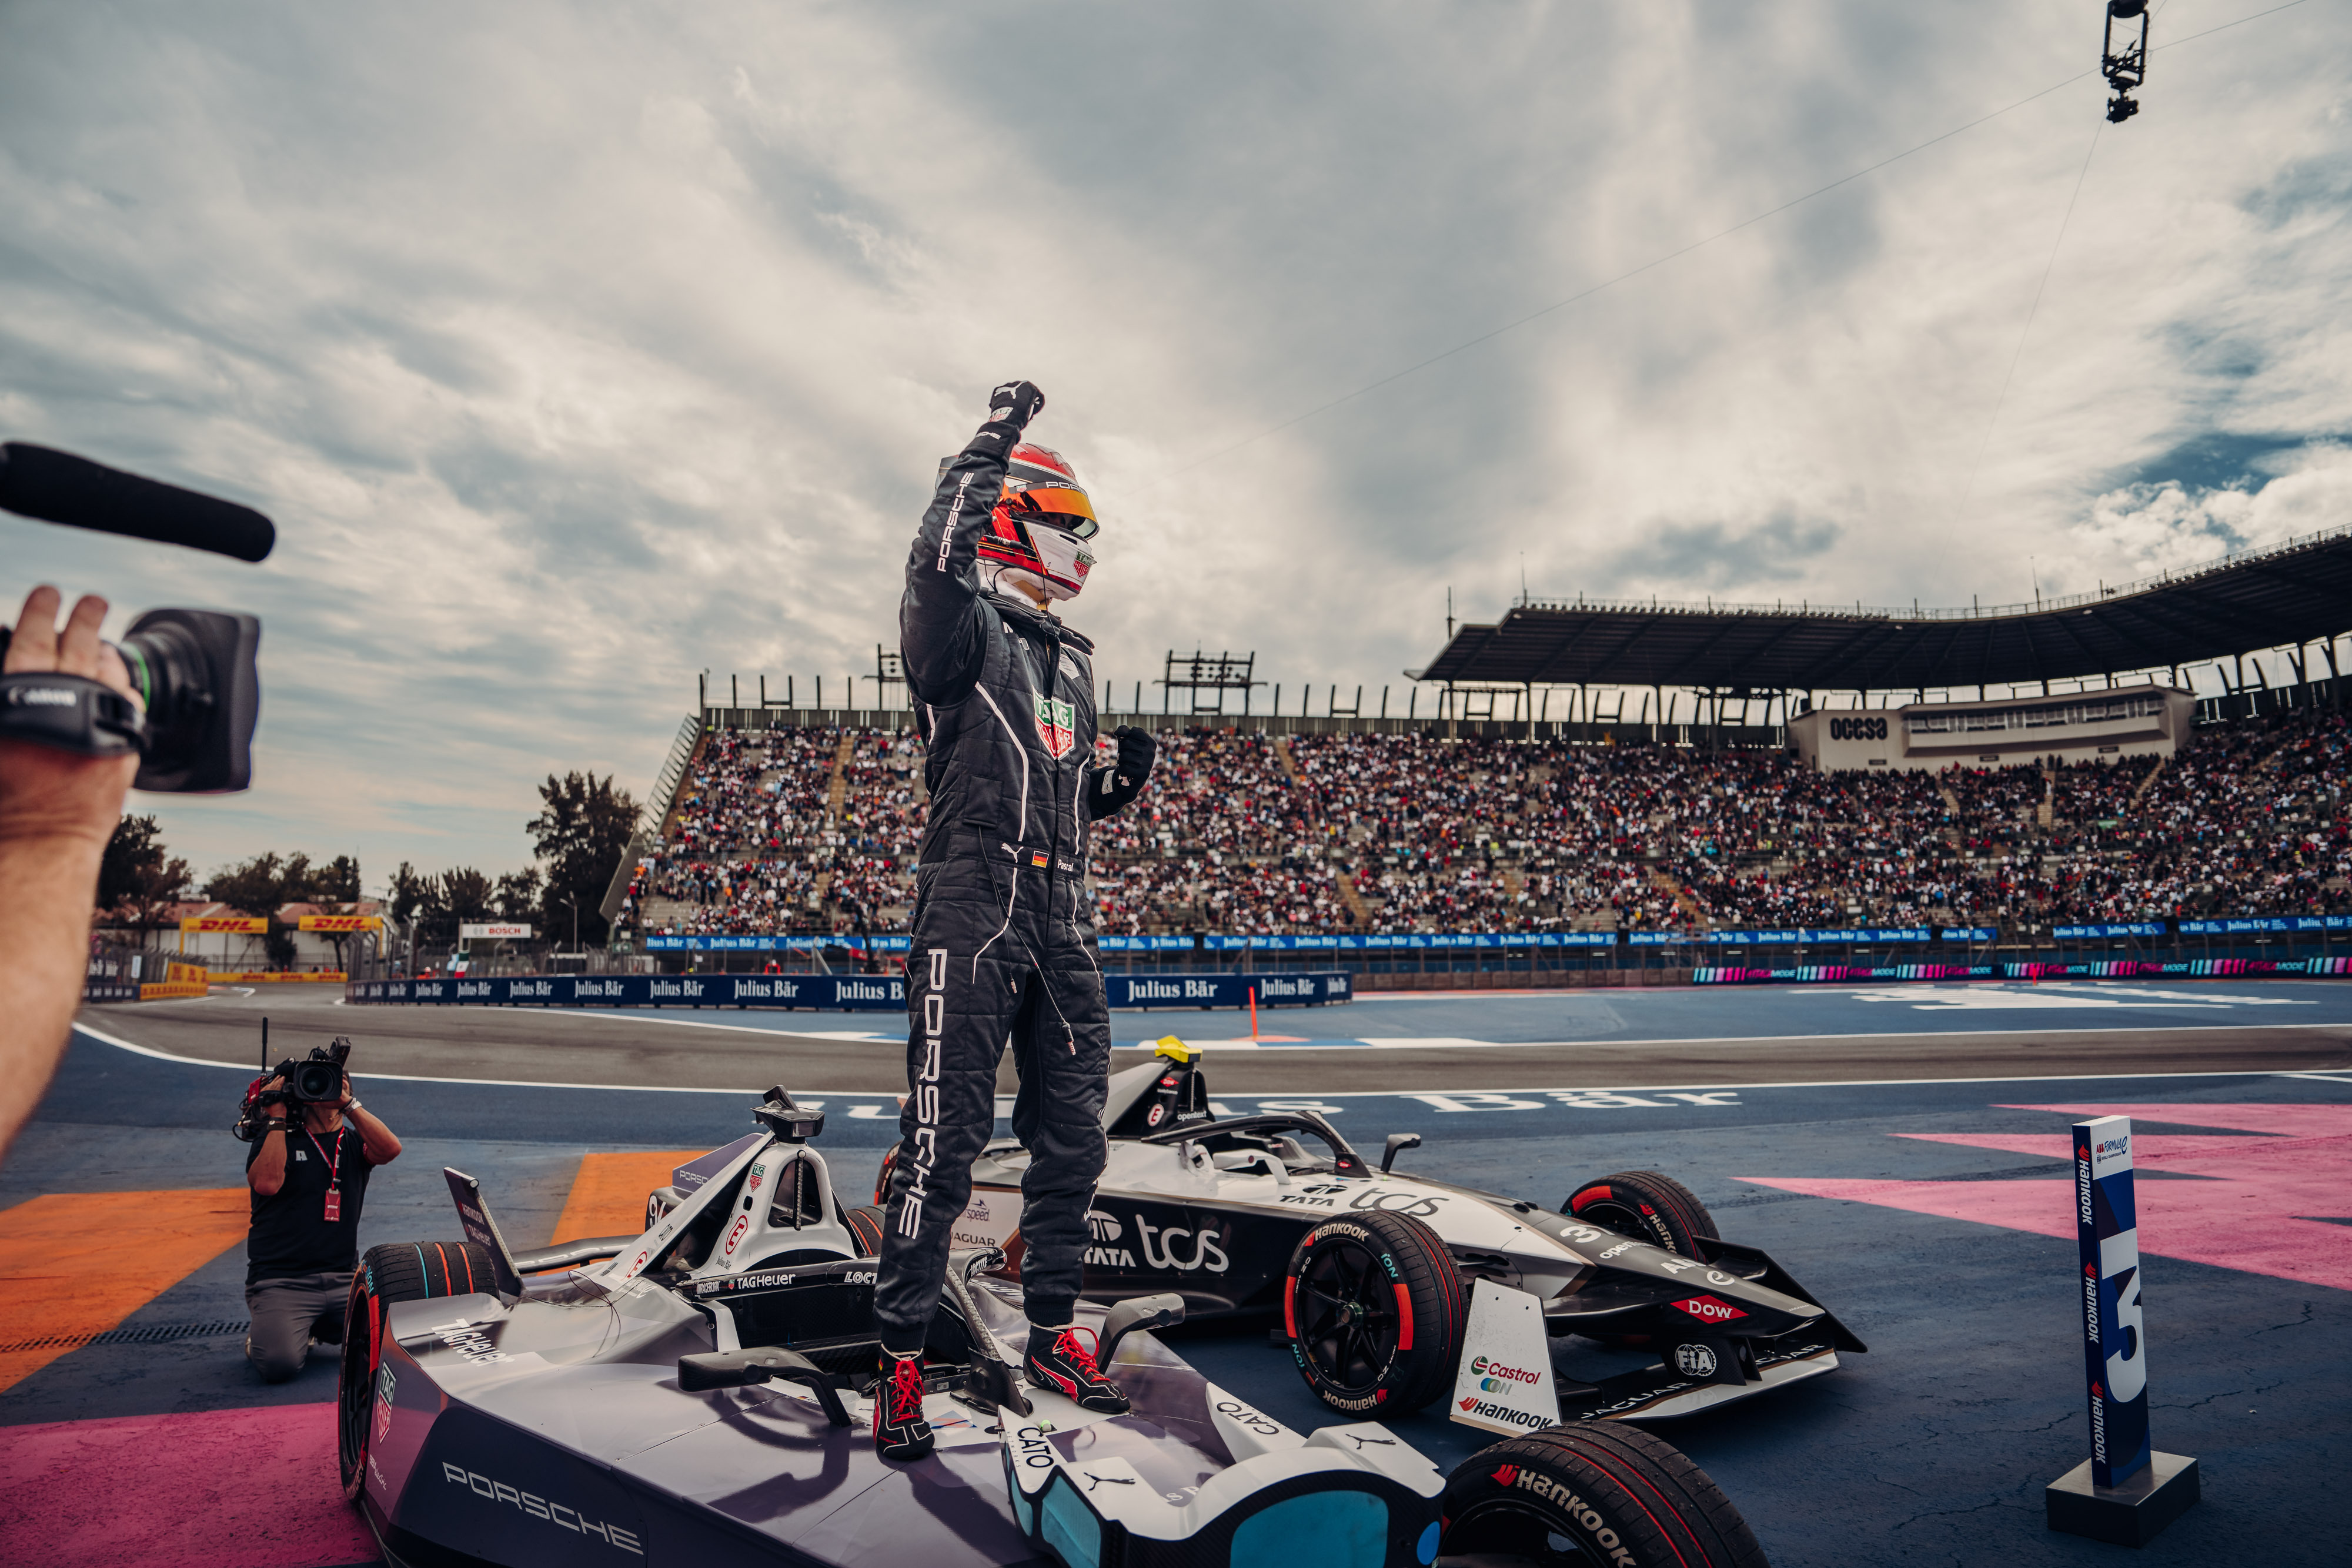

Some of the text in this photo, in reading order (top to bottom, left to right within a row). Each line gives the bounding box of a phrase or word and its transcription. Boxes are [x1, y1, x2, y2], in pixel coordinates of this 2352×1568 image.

[937, 472, 974, 572] PORSCHE
[1036, 698, 1069, 726] TAG
[1057, 859, 1074, 872] Pascal
[489, 927, 521, 935] BOSCH
[509, 981, 552, 998] Julius Bär
[574, 980, 624, 998] Julius Bär
[650, 980, 704, 999] Julius Bär
[734, 979, 799, 999] Julius Bär
[835, 981, 885, 1002] Julius
[1128, 979, 1218, 1002] Julius Bär
[1261, 978, 1315, 999] Julius Bär
[898, 949, 947, 1240] PORSCHE
[1398, 1092, 1743, 1114] Bär
[1151, 1108, 1160, 1122] E
[1177, 1111, 1207, 1122] opentext
[2096, 1143, 2104, 1154] ABB
[2104, 1138, 2122, 1153] FORMULA
[753, 1166, 764, 1176] TAG
[750, 1178, 762, 1190] HEUER
[1279, 1195, 1334, 1206] TATA
[1349, 1187, 1450, 1217] tcs
[1135, 1213, 1229, 1272] tcs
[716, 1255, 726, 1268] Julius
[2100, 1227, 2147, 1403] 3
[1488, 1362, 1541, 1385] Castrol
[383, 1370, 394, 1403] TAG
[1581, 1382, 1693, 1420] JAGUAR
[378, 1398, 391, 1437] HEUER
[1217, 1402, 1279, 1435] CATO
[1017, 1427, 1054, 1468] CATO
[442, 1462, 644, 1555] PORSCHE
